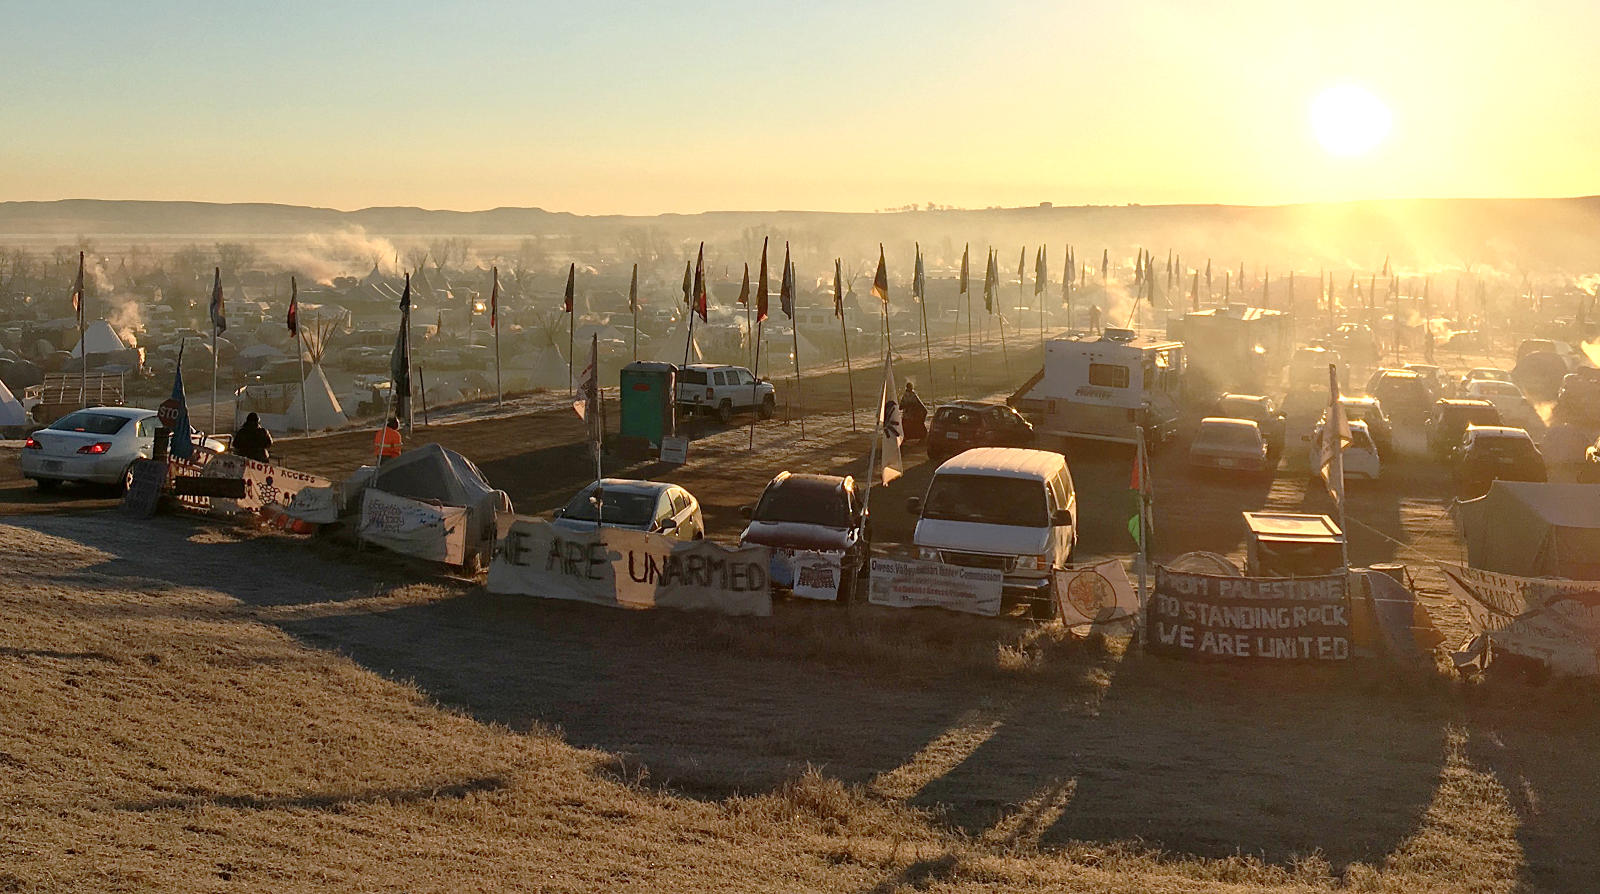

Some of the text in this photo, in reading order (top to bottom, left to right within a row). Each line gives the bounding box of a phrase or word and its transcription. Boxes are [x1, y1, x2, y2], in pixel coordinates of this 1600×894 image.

[159, 406, 179, 419] STO
[281, 469, 316, 484] ACCESS
[545, 536, 608, 580] ARE
[628, 549, 766, 592] UNARMED
[1219, 579, 1344, 601] PALESTINE
[1156, 593, 1349, 630] TO STANDING ROCK
[1155, 621, 1349, 661] WE ARE UNITED
